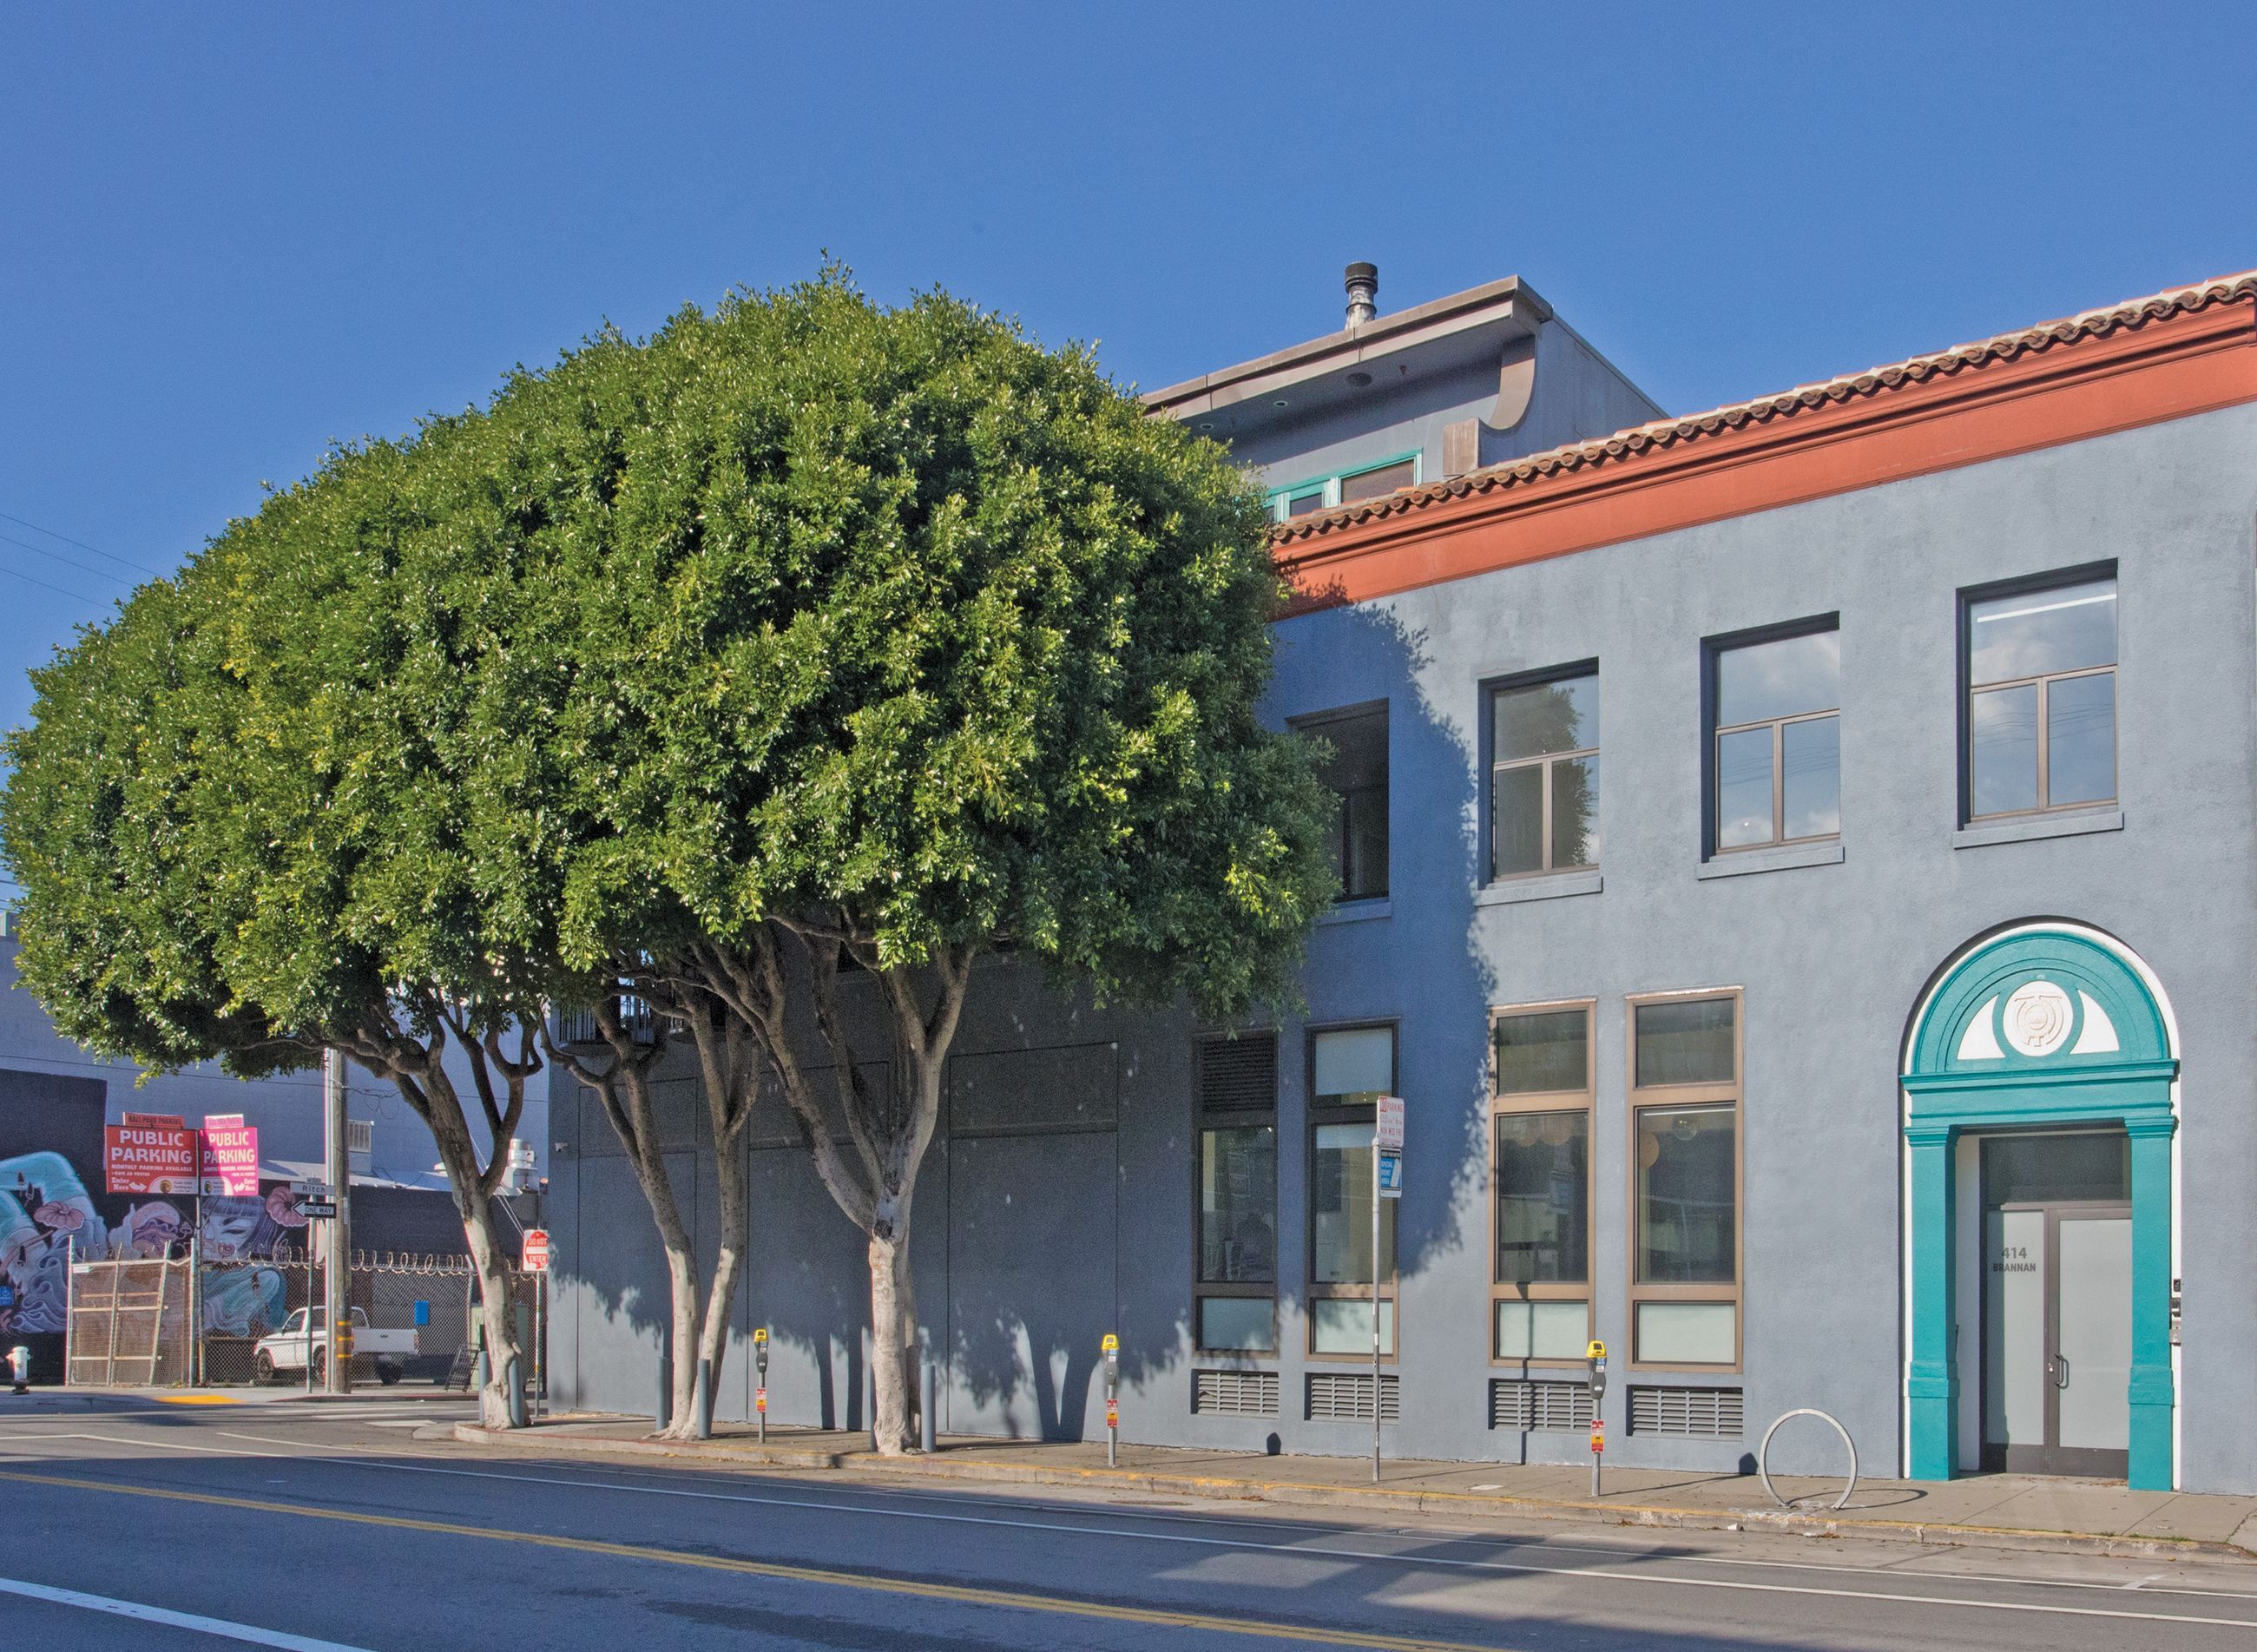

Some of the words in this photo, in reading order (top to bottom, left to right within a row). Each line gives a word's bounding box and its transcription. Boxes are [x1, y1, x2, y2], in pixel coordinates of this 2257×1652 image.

[1388, 1102, 1403, 1112] PARKING
[120, 1129, 184, 1147] PUBLIC
[208, 1131, 249, 1147] PUBLIC
[111, 1147, 193, 1164] PARKING
[203, 1149, 255, 1164] PARKING
[302, 1185, 326, 1194] Ritch
[529, 1237, 536, 1246] DO
[536, 1237, 548, 1246] NOT
[529, 1254, 548, 1263] ENTER
[2002, 1247, 2028, 1259] 414
[1992, 1263, 2037, 1272] BRANNAN
